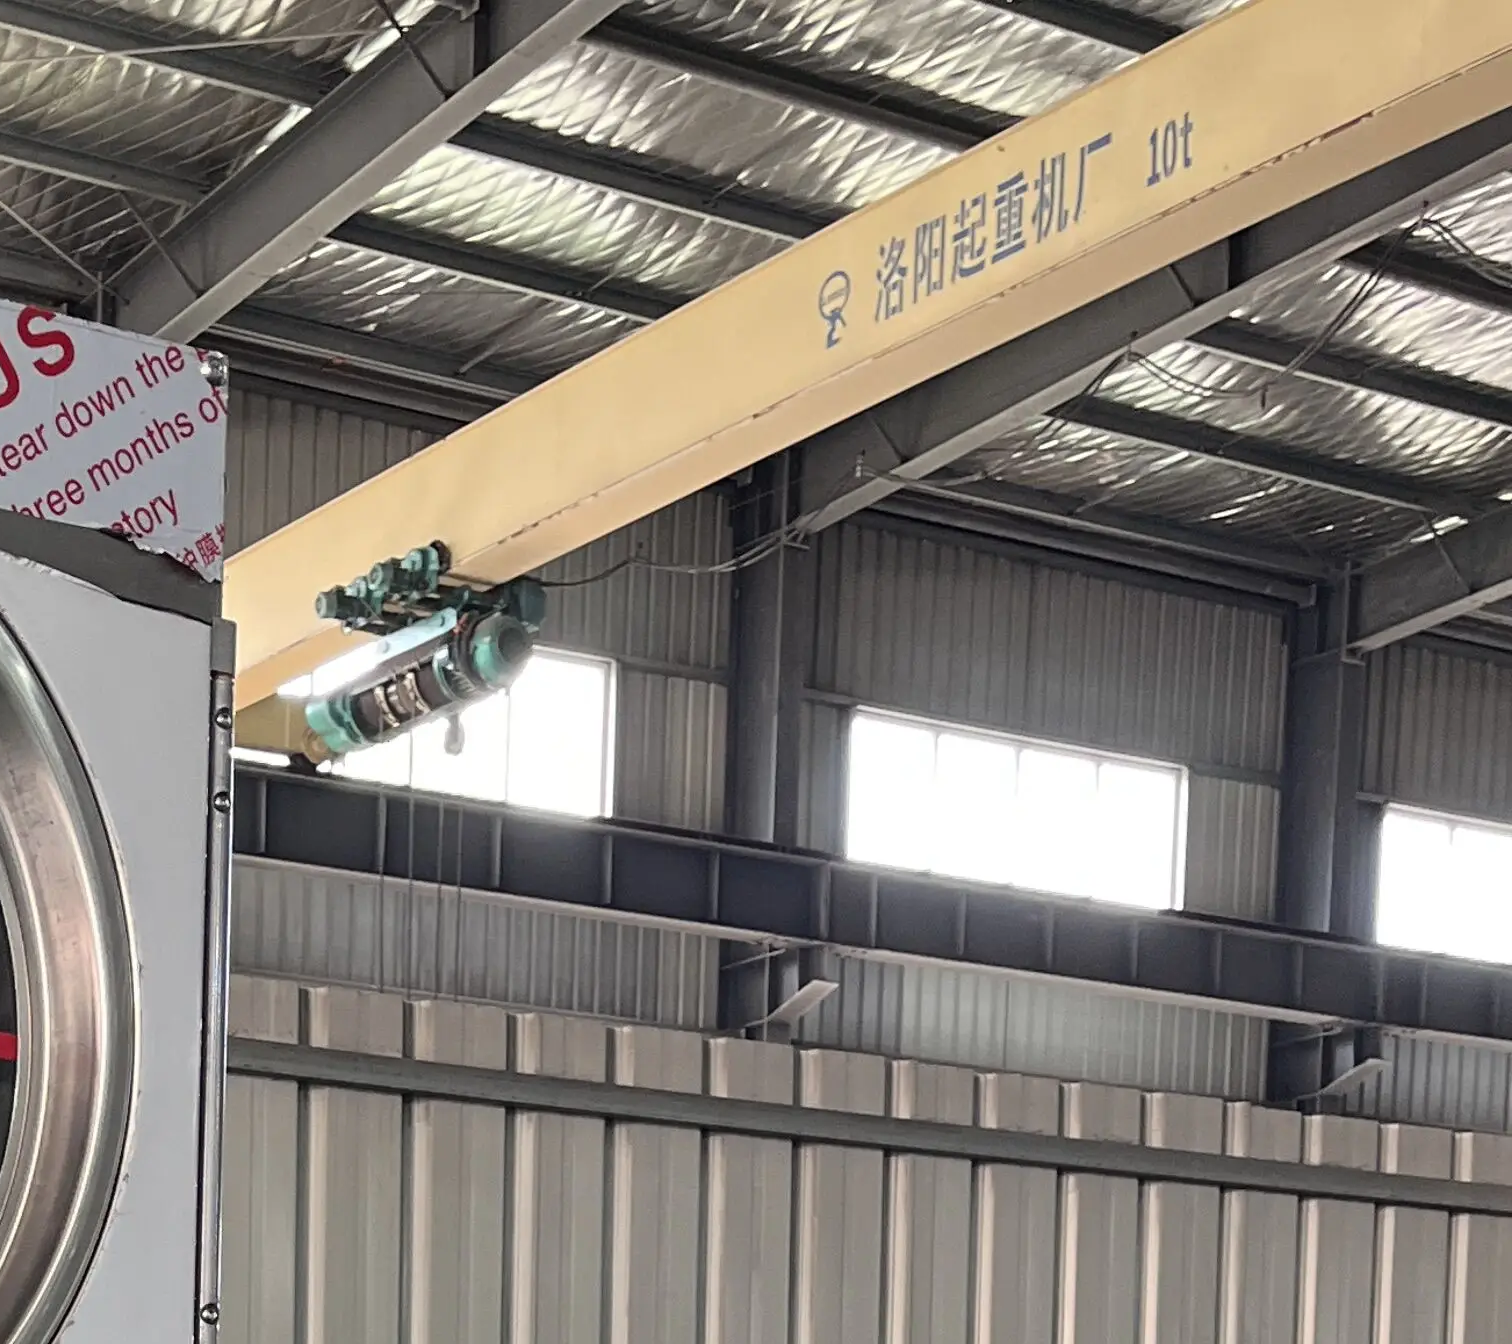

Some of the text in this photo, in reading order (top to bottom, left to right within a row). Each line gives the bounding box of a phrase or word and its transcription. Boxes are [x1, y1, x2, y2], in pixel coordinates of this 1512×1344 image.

[875, 112, 1194, 322] 洛阳起重机厂 10t
[55, 374, 136, 439] down
[135, 344, 185, 390] the
[88, 411, 195, 491] months
